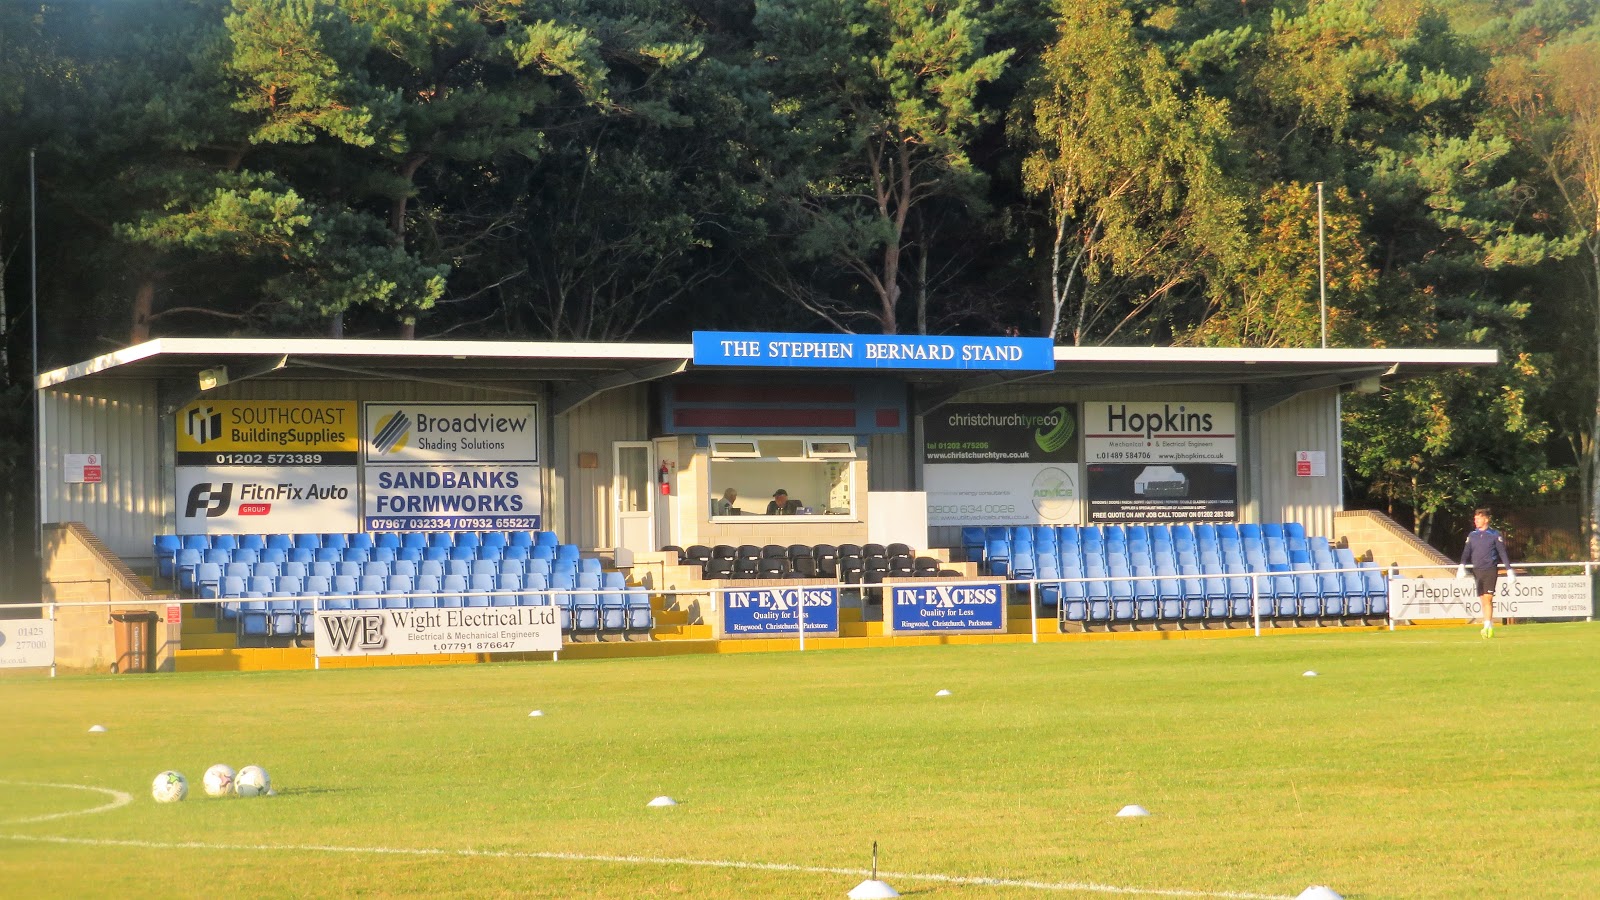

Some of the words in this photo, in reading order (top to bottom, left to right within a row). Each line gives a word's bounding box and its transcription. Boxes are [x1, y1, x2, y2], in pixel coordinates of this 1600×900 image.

[720, 340, 761, 358] THE
[768, 341, 854, 359] STEPHEN
[865, 343, 954, 361] BERNARD
[962, 345, 1023, 362] STAND
[231, 407, 346, 425] SOUTHCOAST
[948, 413, 1059, 429] christchurchtyreco
[1108, 404, 1213, 439] Hopkins
[416, 413, 527, 433] Broadview
[418, 437, 457, 451] Shading
[460, 437, 505, 450] Solutions
[215, 454, 263, 464] 01202
[267, 454, 322, 464] 573389
[927, 452, 1030, 460] www.christchurchtyre.co.uk
[378, 471, 519, 489] SANDBANKS
[240, 483, 304, 500] FitnFix
[305, 483, 349, 500] Auto
[1033, 489, 1073, 498] ADVICE
[376, 495, 523, 513] FORMWORKS
[960, 505, 982, 514] 634
[984, 504, 1015, 514] 0026
[372, 519, 407, 529] 07967
[410, 518, 451, 528] 032334
[459, 518, 493, 528] 07932
[495, 518, 536, 528] 655227
[1402, 585, 1410, 598] P.
[1501, 583, 1510, 597] &
[1515, 582, 1543, 596] Sons
[729, 589, 832, 610] IN-EXCESS
[897, 586, 997, 607] IN-EXCESS
[920, 608, 946, 618] Quality
[948, 608, 958, 616] for
[1466, 602, 1518, 613] ROFING
[392, 612, 441, 632] Wight
[446, 610, 522, 627] Electrical
[528, 608, 556, 625] Ltd
[753, 611, 779, 620] Quality
[781, 611, 791, 619] for
[793, 610, 808, 618] Lss
[734, 624, 763, 632] Ringwood,
[803, 622, 828, 630] Parkstone
[902, 620, 930, 628] Ringwood,
[932, 620, 965, 628] Christchurch,
[968, 619, 993, 627] Parkstone
[18, 628, 44, 636] 01425
[321, 614, 385, 649] WE
[408, 633, 444, 641] Electrical
[501, 631, 540, 640] Engineers
[16, 641, 46, 650] 277000
[477, 642, 515, 650] 876647
